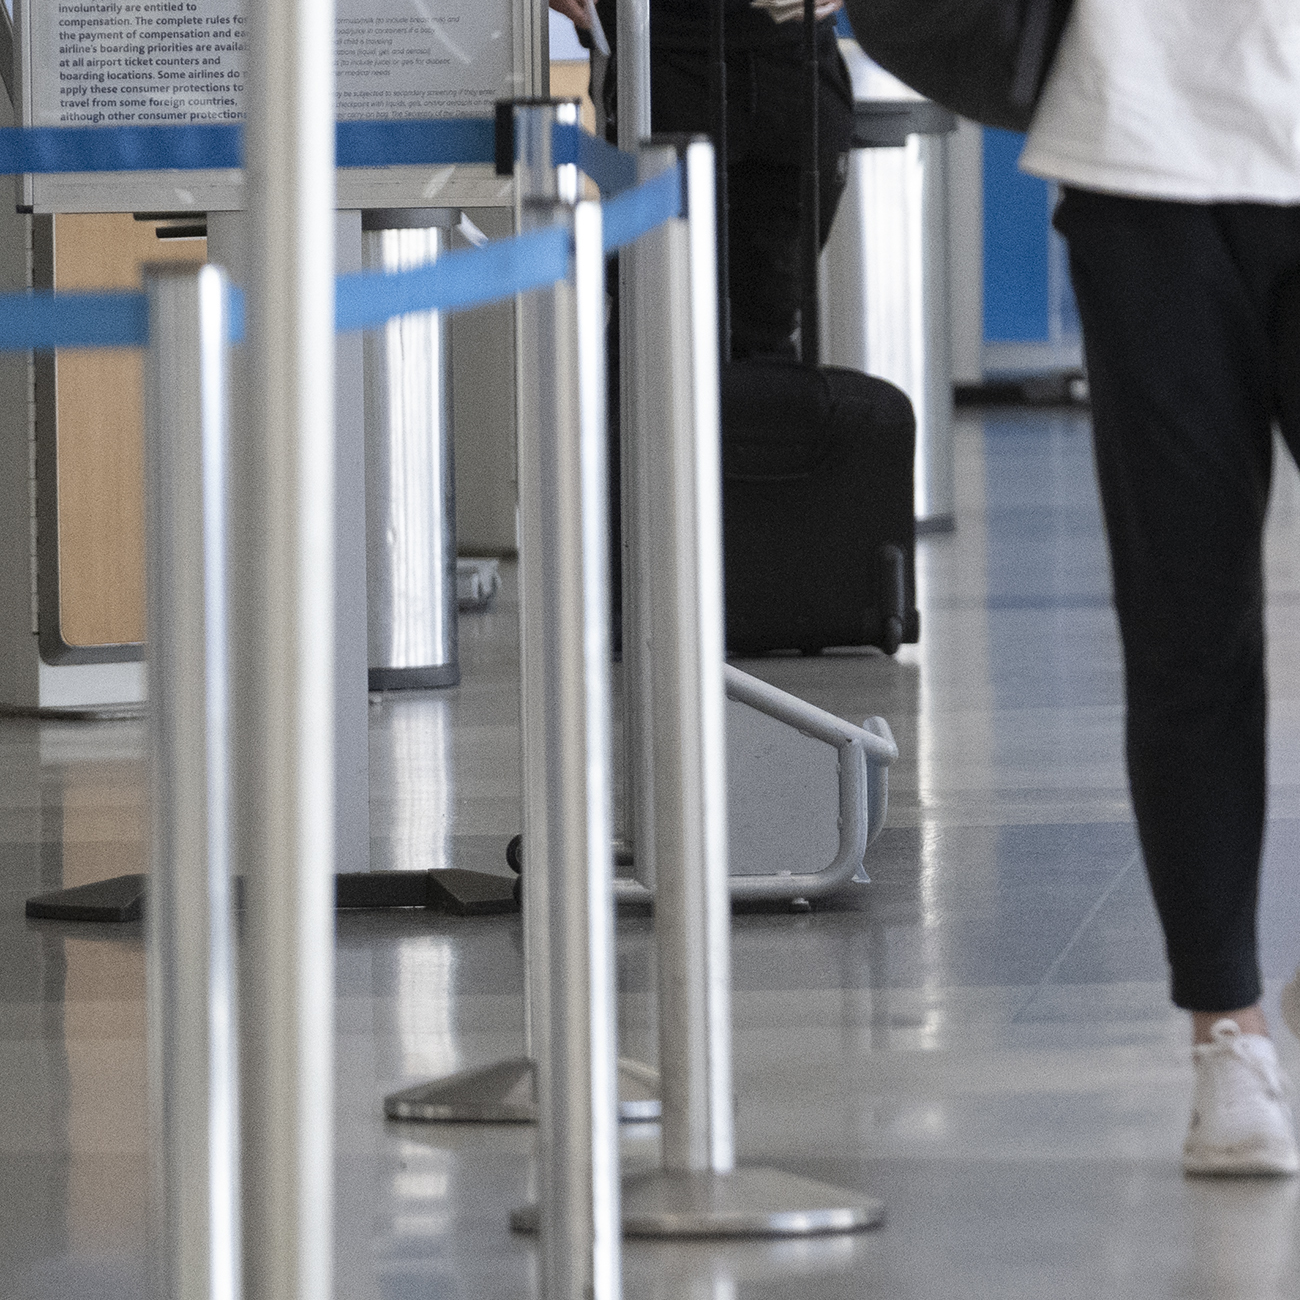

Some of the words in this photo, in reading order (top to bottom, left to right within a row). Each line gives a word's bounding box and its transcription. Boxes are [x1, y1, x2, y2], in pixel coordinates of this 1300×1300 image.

[60, 57, 70, 67] at
[72, 56, 84, 66] all
[87, 56, 122, 69] airport
[124, 55, 153, 66] ticket
[156, 55, 200, 66] counters
[203, 54, 220, 65] and
[60, 96, 89, 107] travel
[92, 96, 117, 107] from
[119, 98, 147, 106] some
[149, 95, 185, 109] foreign
[188, 95, 238, 107] countries,
[61, 110, 105, 124] although
[108, 109, 135, 120] other
[138, 111, 186, 120] consumer
